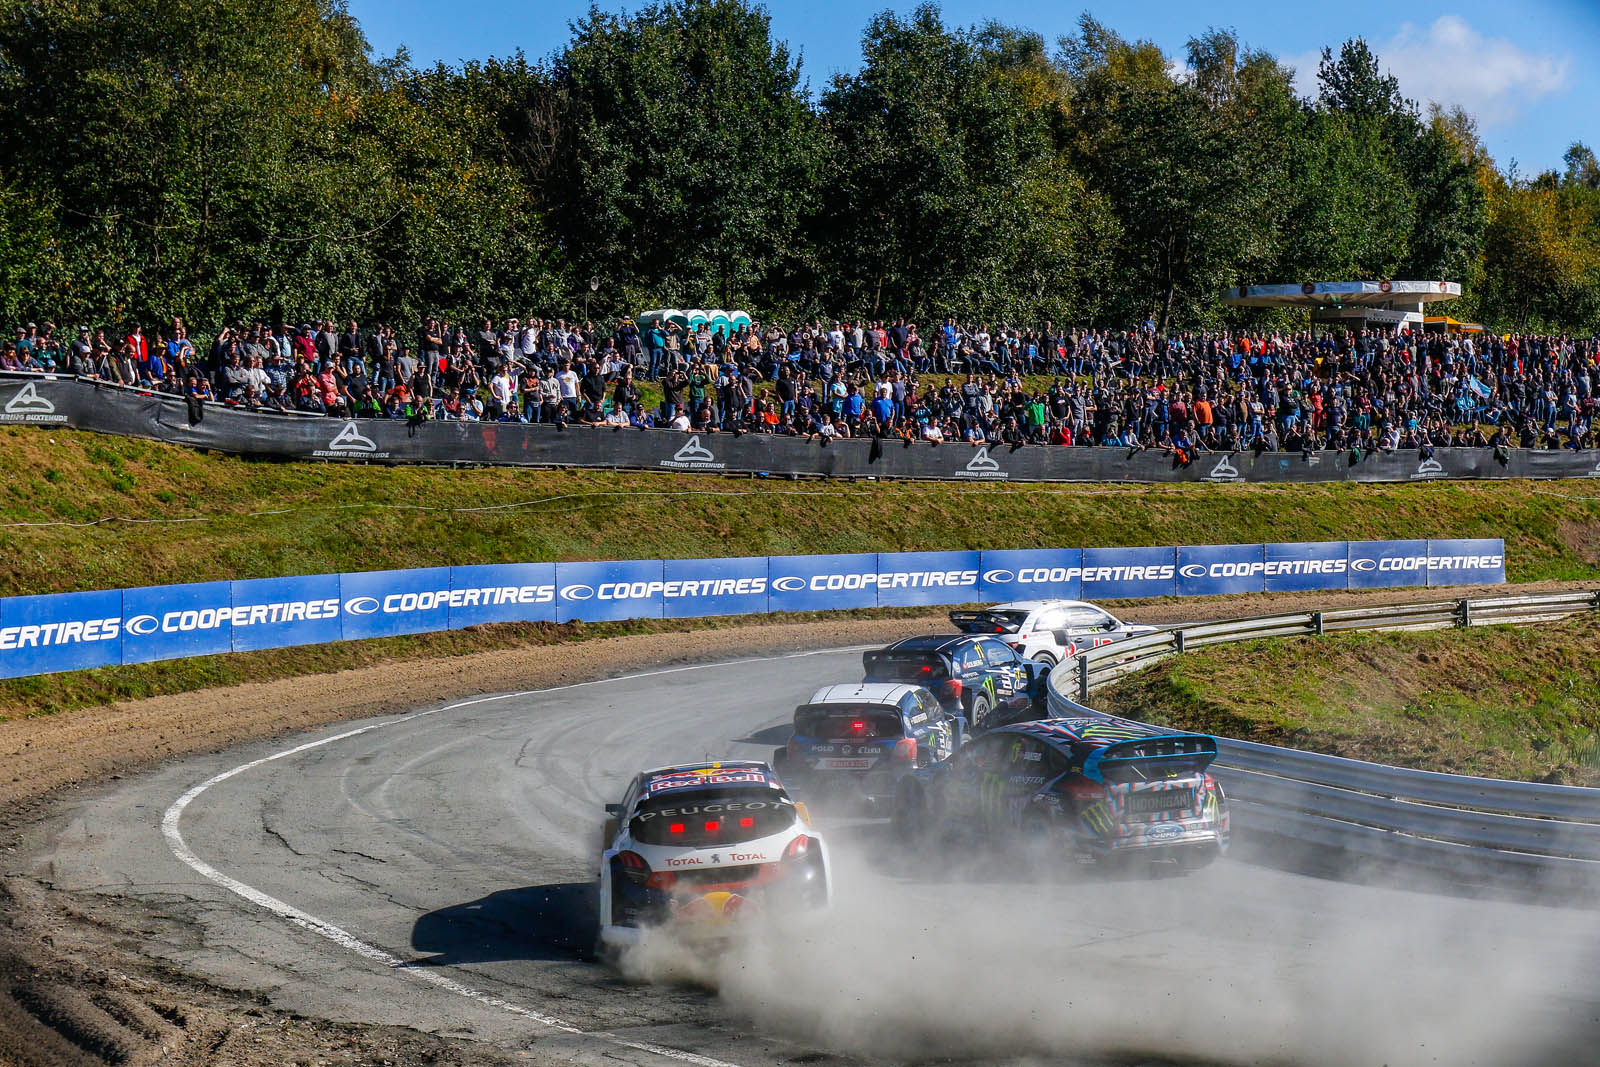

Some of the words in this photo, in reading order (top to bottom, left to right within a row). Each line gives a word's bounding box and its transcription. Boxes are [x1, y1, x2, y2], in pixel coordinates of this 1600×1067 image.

[1210, 559, 1348, 578] COOPERTIRES
[1379, 555, 1503, 571] COOPERTIRES
[810, 570, 978, 591] COOPERTIRES
[1018, 564, 1175, 583] COOPERTIRES
[597, 577, 767, 600] COOPERTIRES
[383, 585, 555, 613] COOPERTIRES
[161, 598, 340, 633] COOPERTIRES
[650, 775, 708, 792] Red
[709, 773, 766, 785] Bull
[638, 801, 783, 823] PEUGEOT
[664, 857, 704, 867] TOTAL
[729, 852, 767, 862] TOTAL
